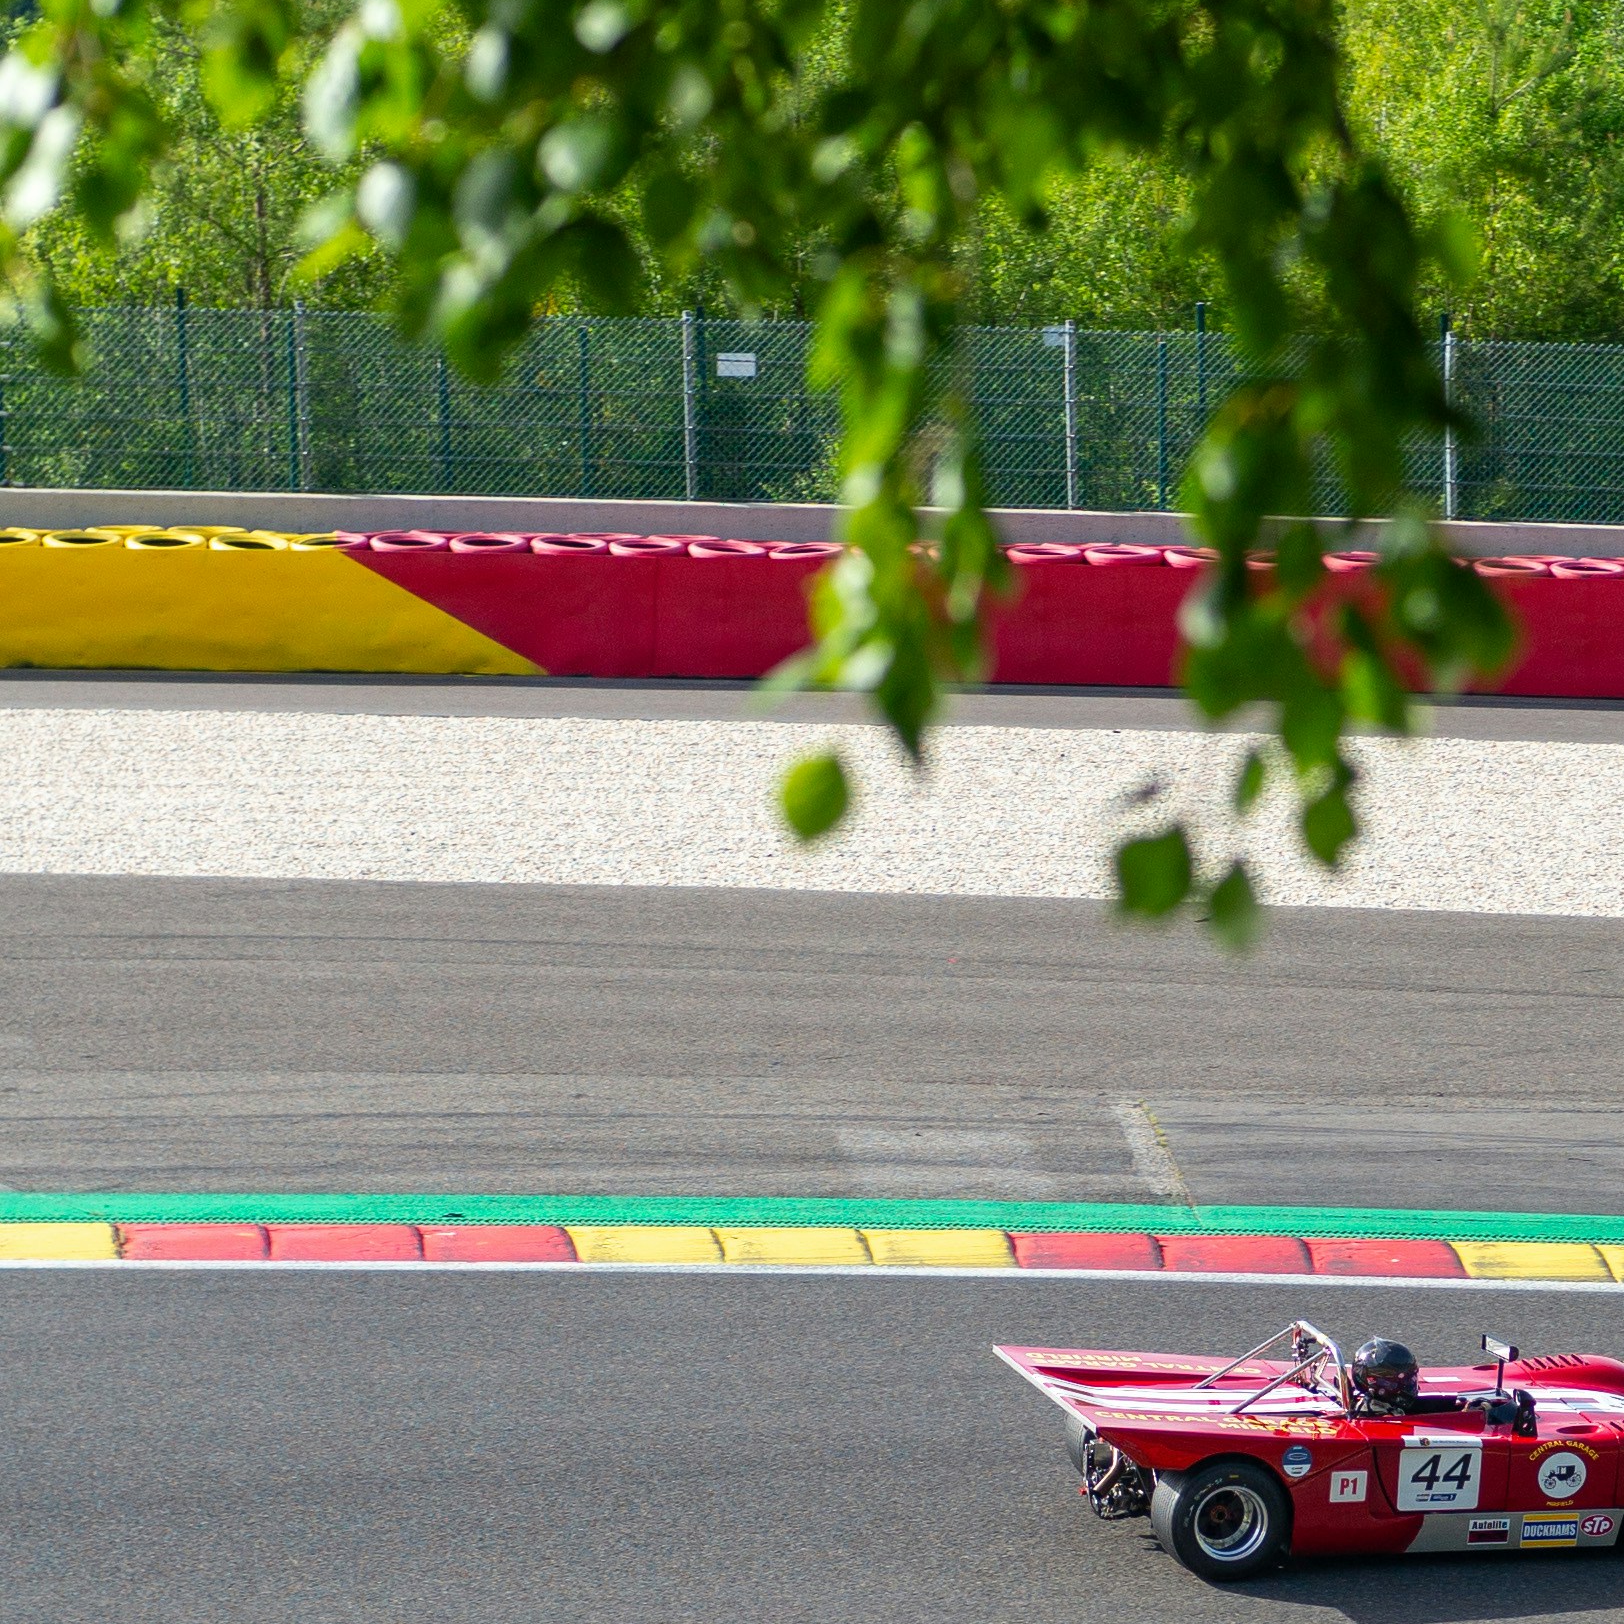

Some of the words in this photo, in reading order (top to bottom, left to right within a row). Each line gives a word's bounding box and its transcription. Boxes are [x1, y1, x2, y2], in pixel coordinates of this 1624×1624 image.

[1094, 1411, 1218, 1423] CENTRAL
[1529, 1440, 1565, 1461] CENTRAL
[1565, 1440, 1600, 1461] GARAGE
[1411, 1452, 1472, 1491] 44
[1339, 1477, 1358, 1496] P1
[1471, 1520, 1508, 1530] Autolite
[1523, 1523, 1576, 1538] DUCKHAMS
[1584, 1516, 1610, 1533] STP
